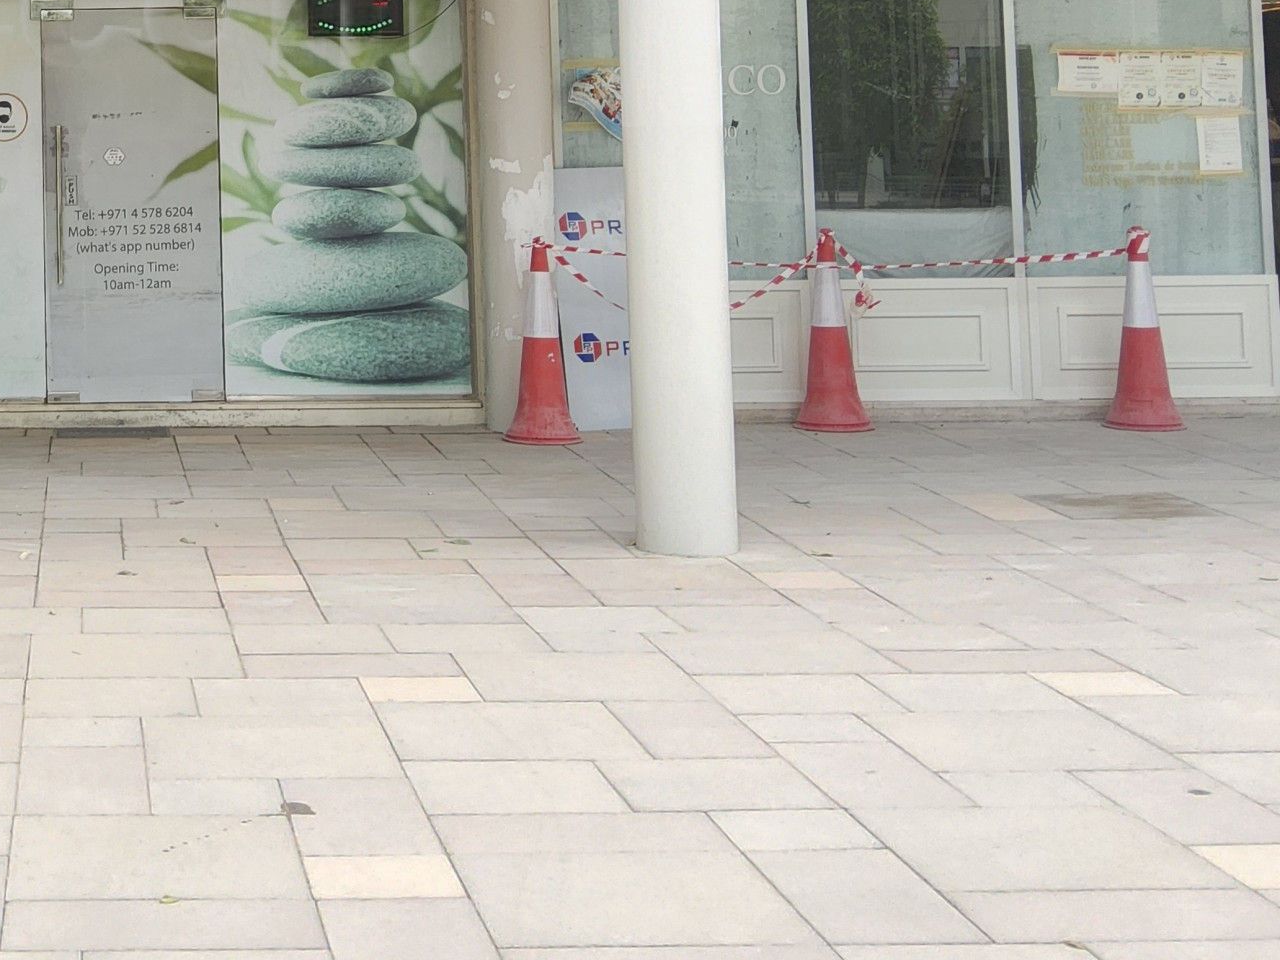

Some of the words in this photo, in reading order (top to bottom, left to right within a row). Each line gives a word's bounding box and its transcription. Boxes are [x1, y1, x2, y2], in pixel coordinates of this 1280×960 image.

[74, 209, 95, 220] Tel:
[98, 208, 127, 220] +971
[131, 208, 138, 219] 4
[141, 207, 162, 218] 578
[165, 206, 193, 218] 6204
[68, 226, 98, 237] Mob:
[100, 225, 128, 236] +971
[132, 224, 146, 235] 52
[149, 223, 171, 234] 528
[173, 222, 202, 234] 6814
[76, 241, 117, 254] (what's
[120, 243, 142, 254] app
[145, 238, 195, 251] number)
[94, 262, 144, 276] Opening
[147, 261, 179, 272] Time:
[104, 278, 172, 290] 10am-12am
